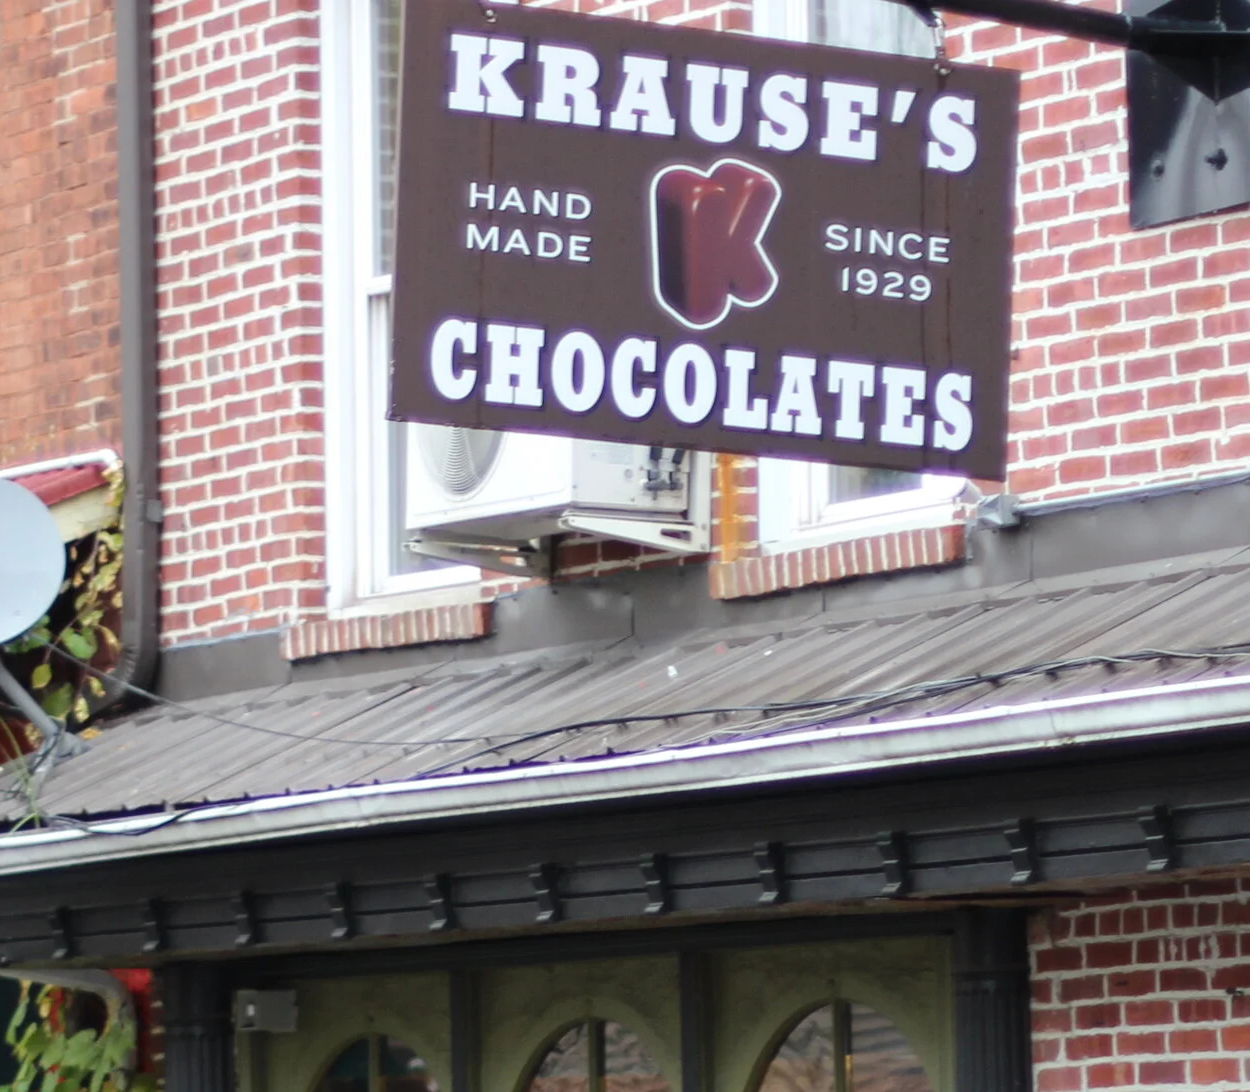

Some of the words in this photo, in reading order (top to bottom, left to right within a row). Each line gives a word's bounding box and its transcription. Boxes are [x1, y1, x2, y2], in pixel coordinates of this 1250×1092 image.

[448, 33, 978, 174] KRAUSE'S
[467, 181, 593, 222] HAND
[465, 223, 593, 263] MADE
[824, 223, 951, 264] SINCE
[841, 266, 933, 302] 1929
[430, 318, 974, 453] CHOCOLATES
